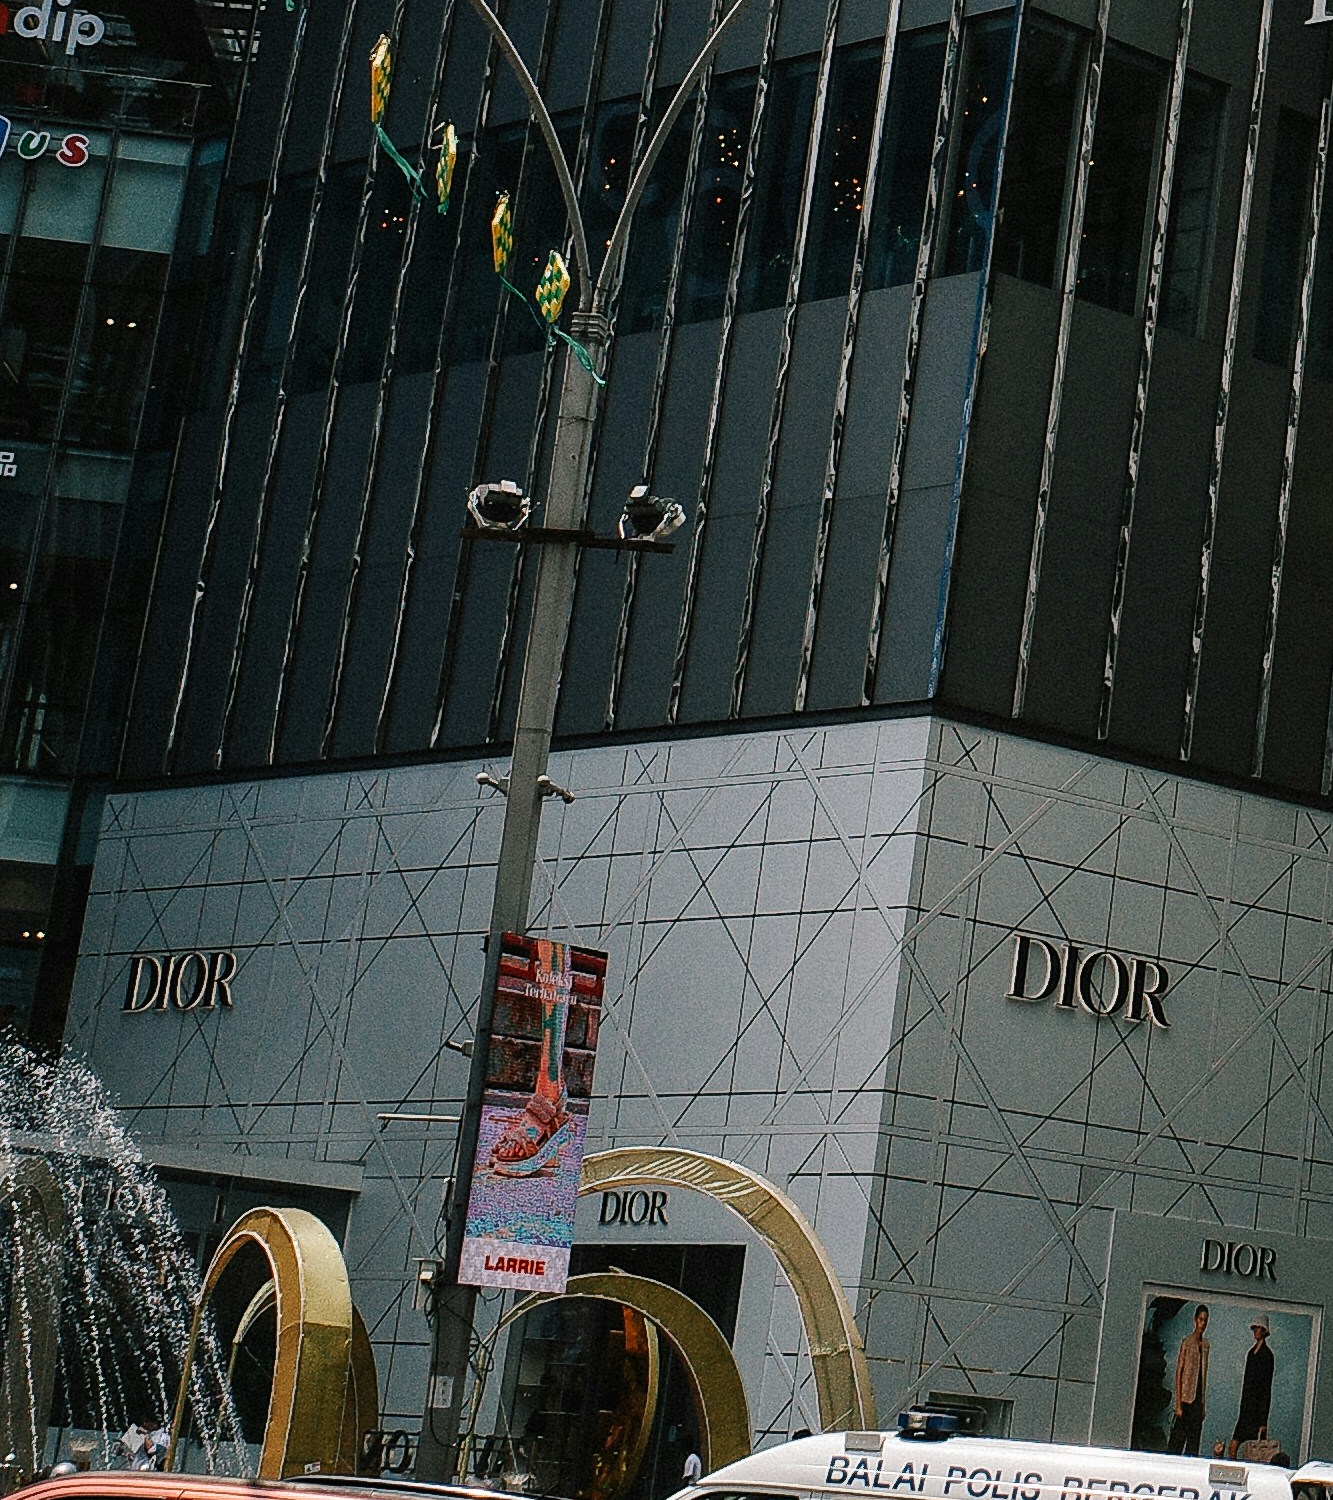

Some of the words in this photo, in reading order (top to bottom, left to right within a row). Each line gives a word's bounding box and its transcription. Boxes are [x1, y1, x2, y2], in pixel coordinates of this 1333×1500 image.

[121, 950, 237, 1013] DIOR
[1005, 933, 1171, 1029] DIOR
[598, 1190, 670, 1226] DIOR
[484, 1254, 547, 1276] LARRIE
[1200, 1237, 1278, 1282] DIOR
[825, 1455, 930, 1493] BALAI
